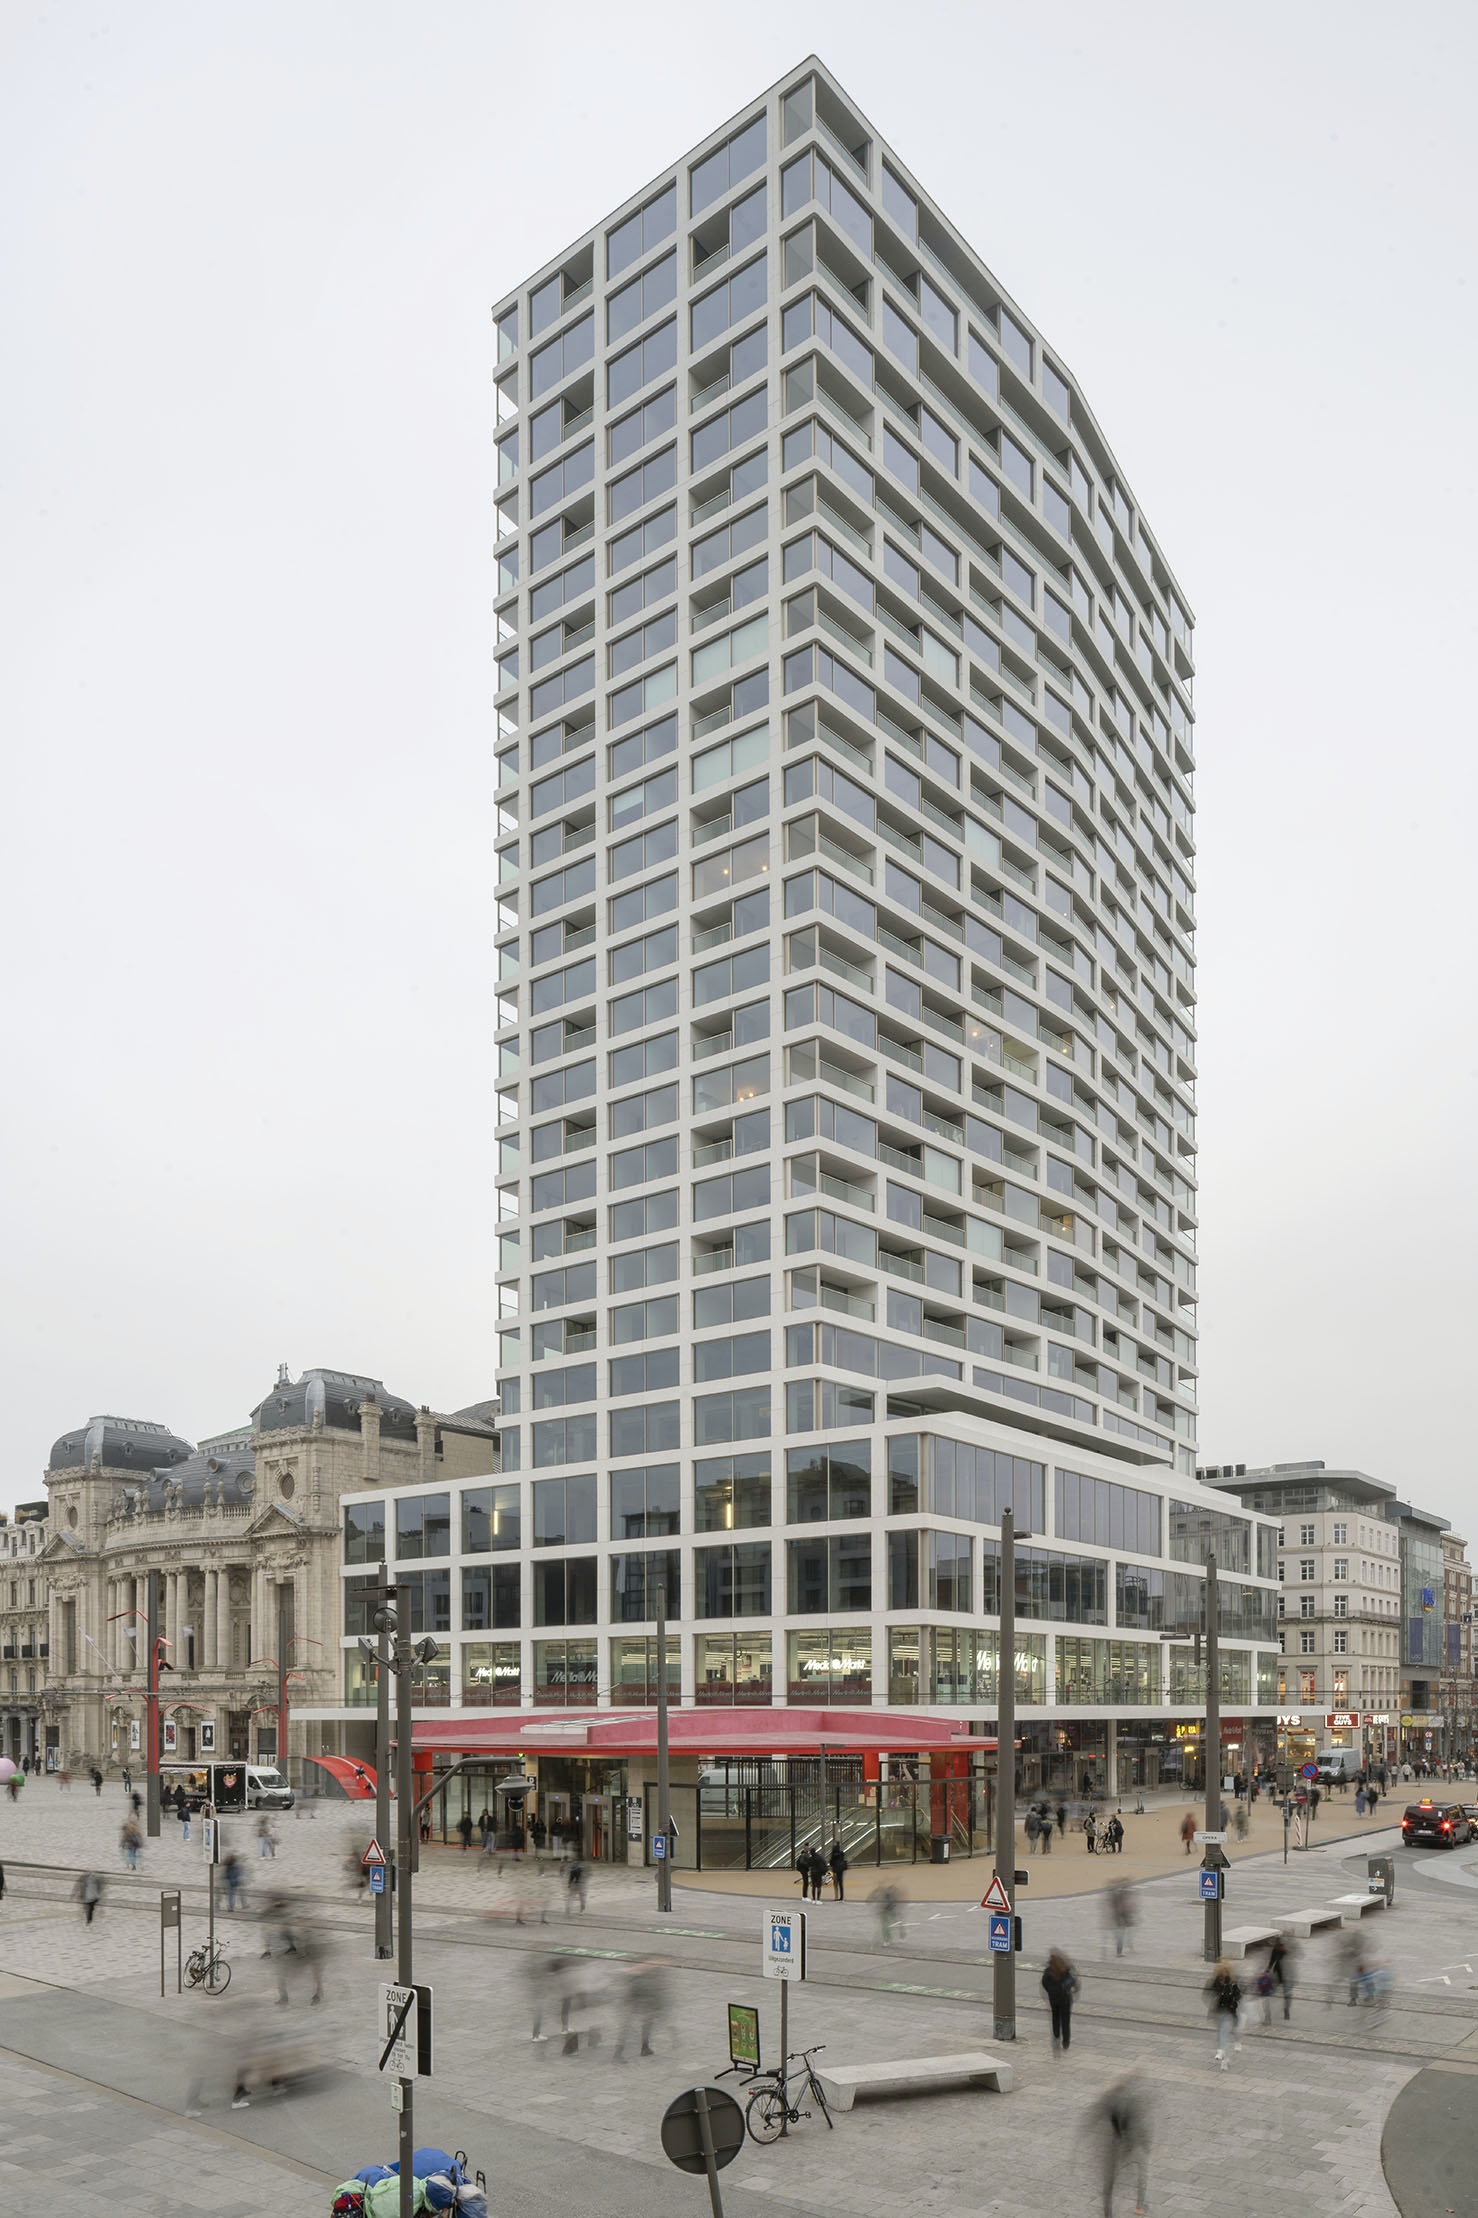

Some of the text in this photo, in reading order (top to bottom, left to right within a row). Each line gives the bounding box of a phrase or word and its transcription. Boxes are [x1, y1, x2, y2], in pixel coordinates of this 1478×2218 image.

[770, 1914, 792, 1925] ZONE
[991, 1940, 1008, 1948] TRAM
[385, 1989, 407, 2004] ZONE
